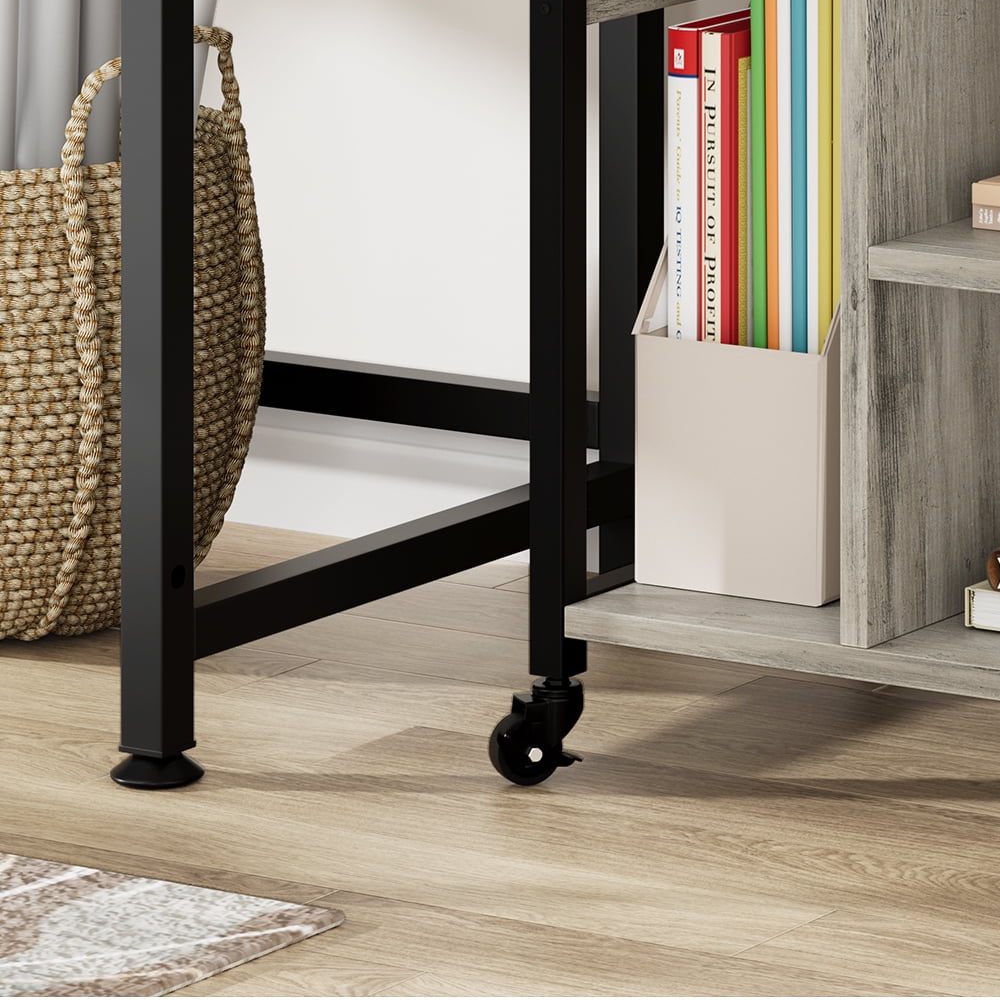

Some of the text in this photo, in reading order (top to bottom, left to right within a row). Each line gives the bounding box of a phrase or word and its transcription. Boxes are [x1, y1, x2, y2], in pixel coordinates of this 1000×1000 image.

[704, 68, 717, 341] IN PURSUIT OF PROFIT
